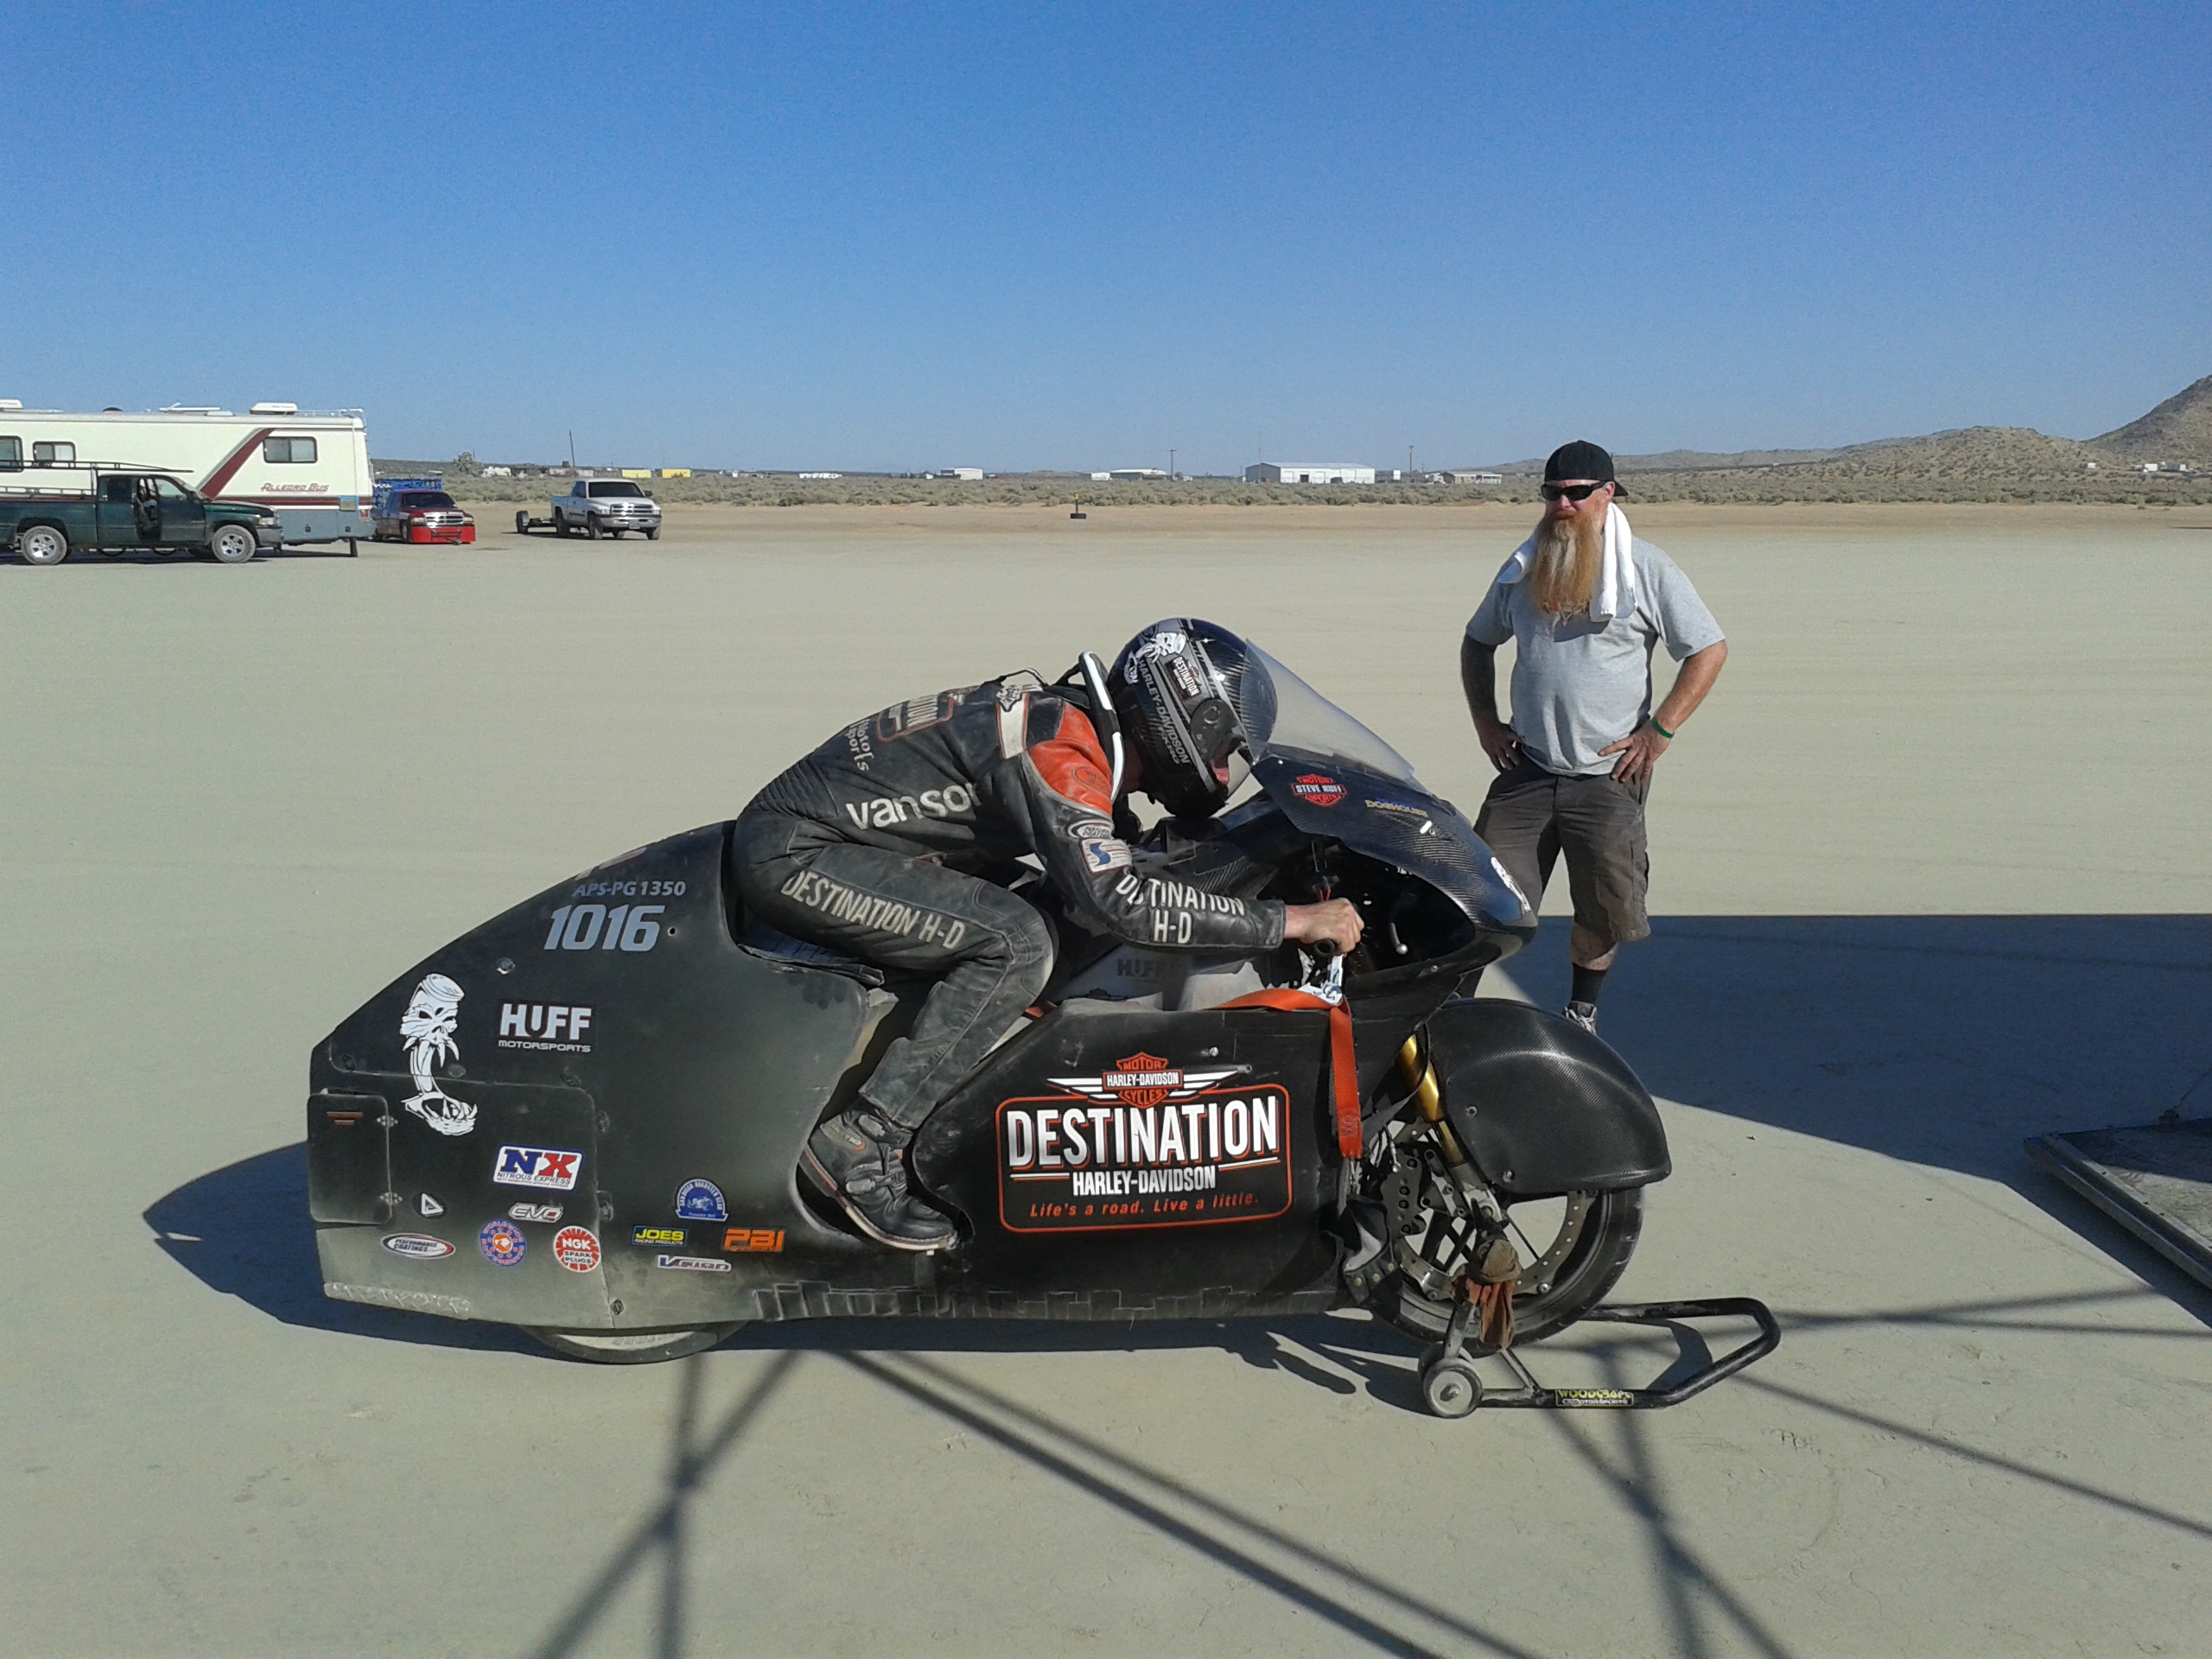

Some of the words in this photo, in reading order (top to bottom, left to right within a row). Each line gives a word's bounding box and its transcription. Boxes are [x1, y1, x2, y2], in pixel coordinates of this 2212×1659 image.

[1137, 658, 1191, 764] HARLEY-DAVIDSON
[640, 881, 686, 896] 1350
[780, 869, 921, 937] DESTINATION
[918, 913, 966, 950] H-D
[543, 904, 666, 952] 1016
[1154, 909, 1192, 944] H-D
[499, 1003, 592, 1040] HUFF
[498, 1039, 592, 1053] MOTORSPORTS
[1122, 1056, 1163, 1071] MOTOR
[1106, 1071, 1179, 1088] HARLEY-DAVIDSON
[1122, 1089, 1164, 1106] CYCLES
[1007, 1096, 1281, 1169] DESTINATION
[500, 1147, 578, 1179] NX
[497, 1171, 532, 1181] NITROUS
[533, 1174, 571, 1185] EXPRESS
[1072, 1165, 1217, 1197] HARLEY-DAVIDSON
[1029, 1202, 1077, 1217] Life's
[1084, 1204, 1094, 1216] a
[1102, 1200, 1145, 1215] road.
[1154, 1198, 1188, 1213] Live
[1196, 1198, 1205, 1210] a
[1212, 1191, 1259, 1208] little.
[563, 1238, 592, 1250] NGK
[635, 1228, 684, 1242] JOES
[394, 1243, 429, 1252] COATINGS
